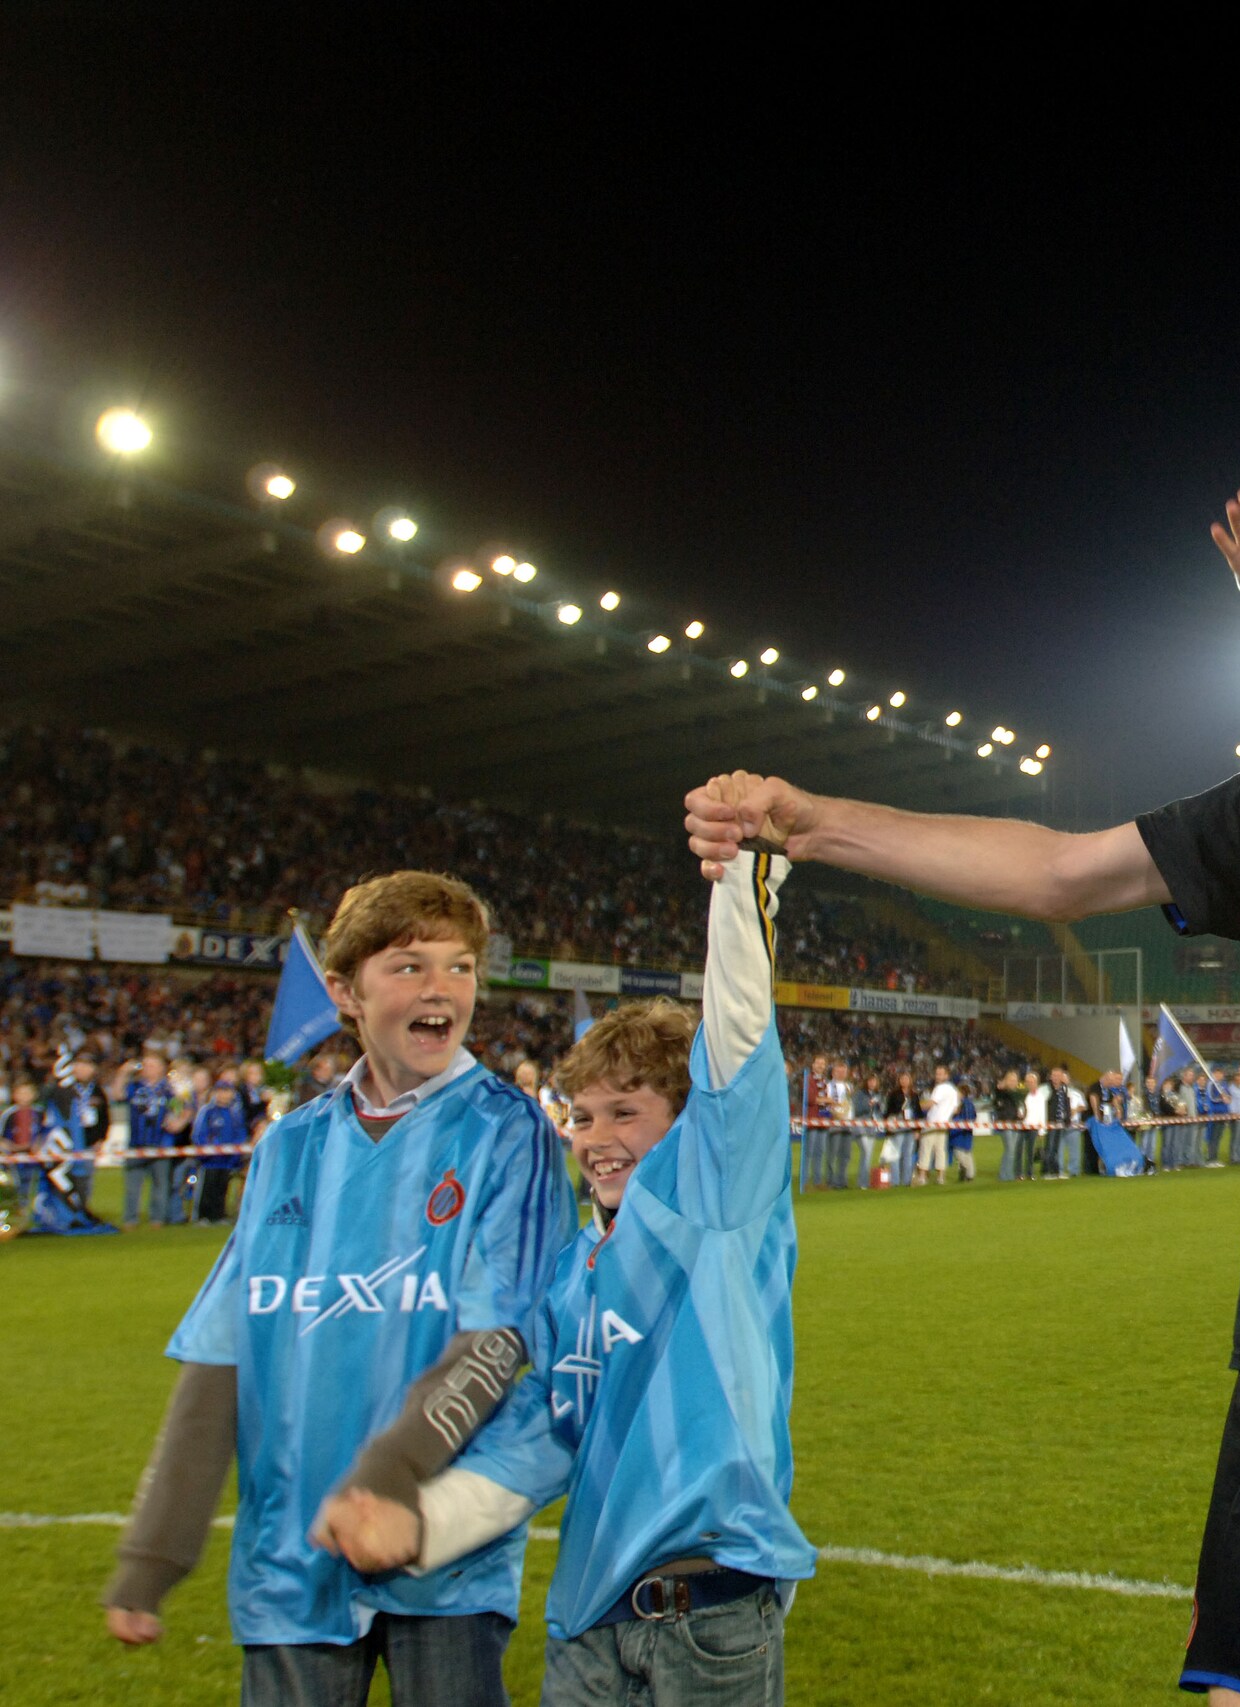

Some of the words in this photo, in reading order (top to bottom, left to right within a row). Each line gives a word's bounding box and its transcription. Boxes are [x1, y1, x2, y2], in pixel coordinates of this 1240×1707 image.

[860, 992, 897, 1011] hansa
[902, 998, 938, 1014] reizen
[248, 1245, 449, 1337] DEXIA
